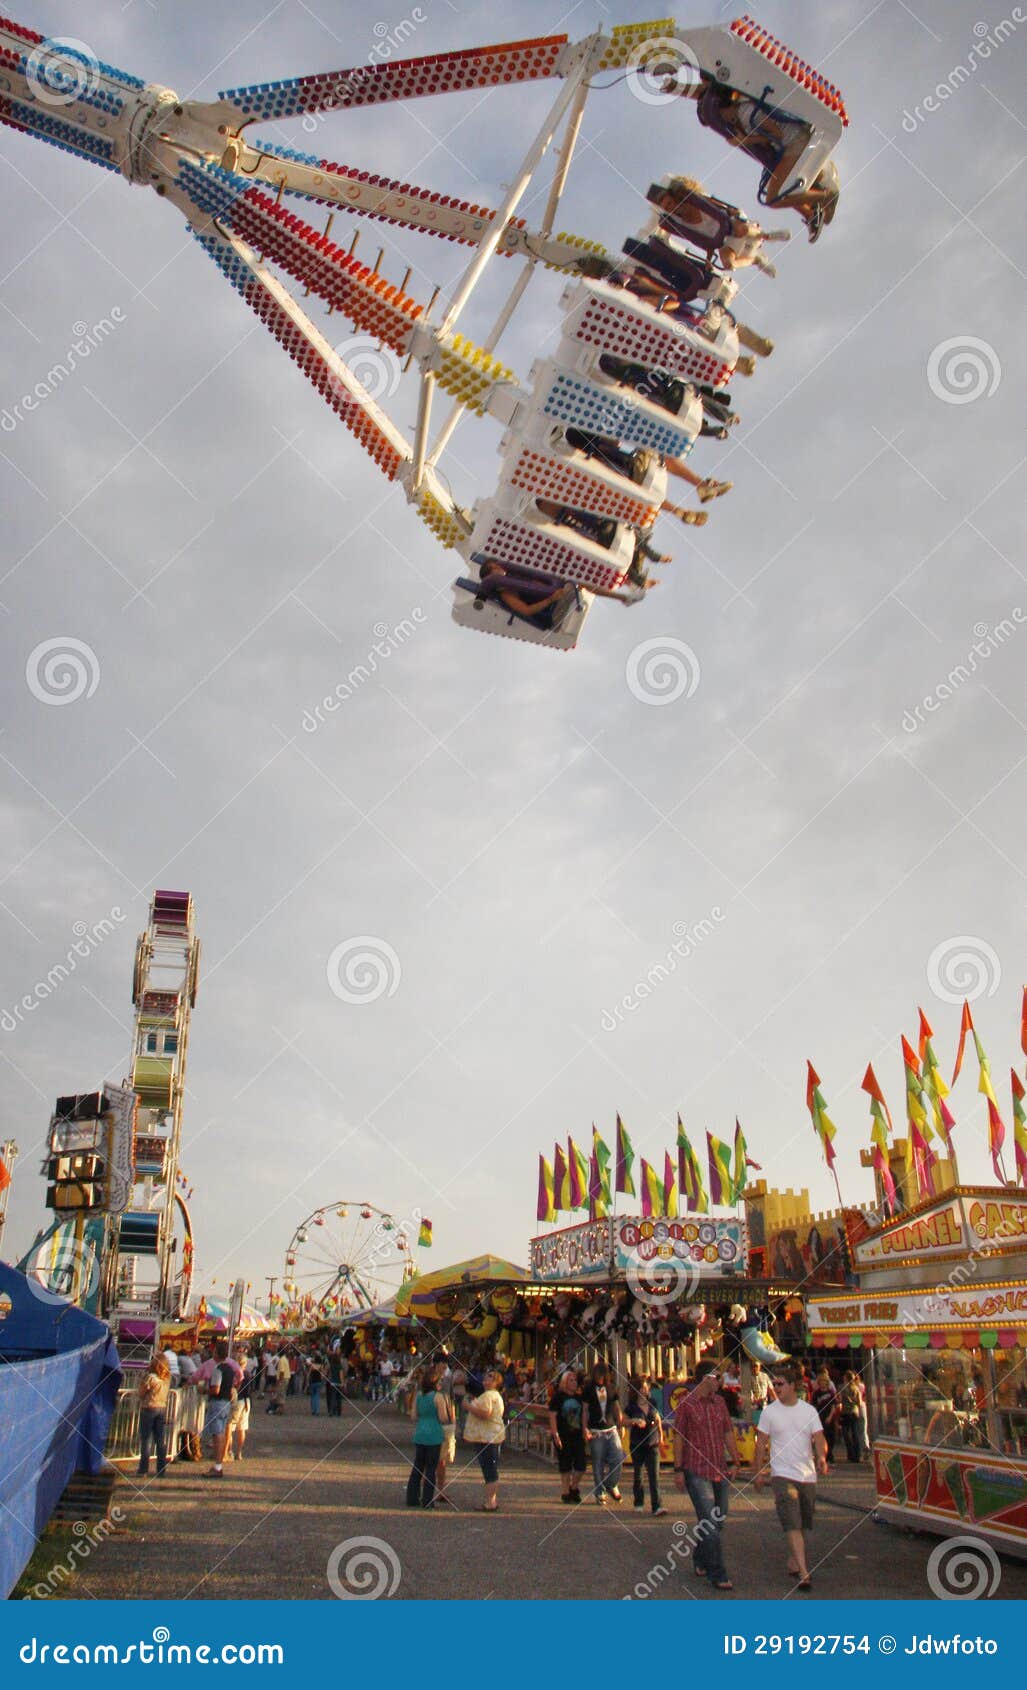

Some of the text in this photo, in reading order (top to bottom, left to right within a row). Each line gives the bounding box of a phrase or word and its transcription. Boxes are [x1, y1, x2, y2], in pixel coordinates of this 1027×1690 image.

[621, 1222, 715, 1246] RISING
[880, 1207, 962, 1253] FUNNEL
[639, 1239, 735, 1261] WATERS
[818, 1302, 899, 1323] FRENCH FRIES
